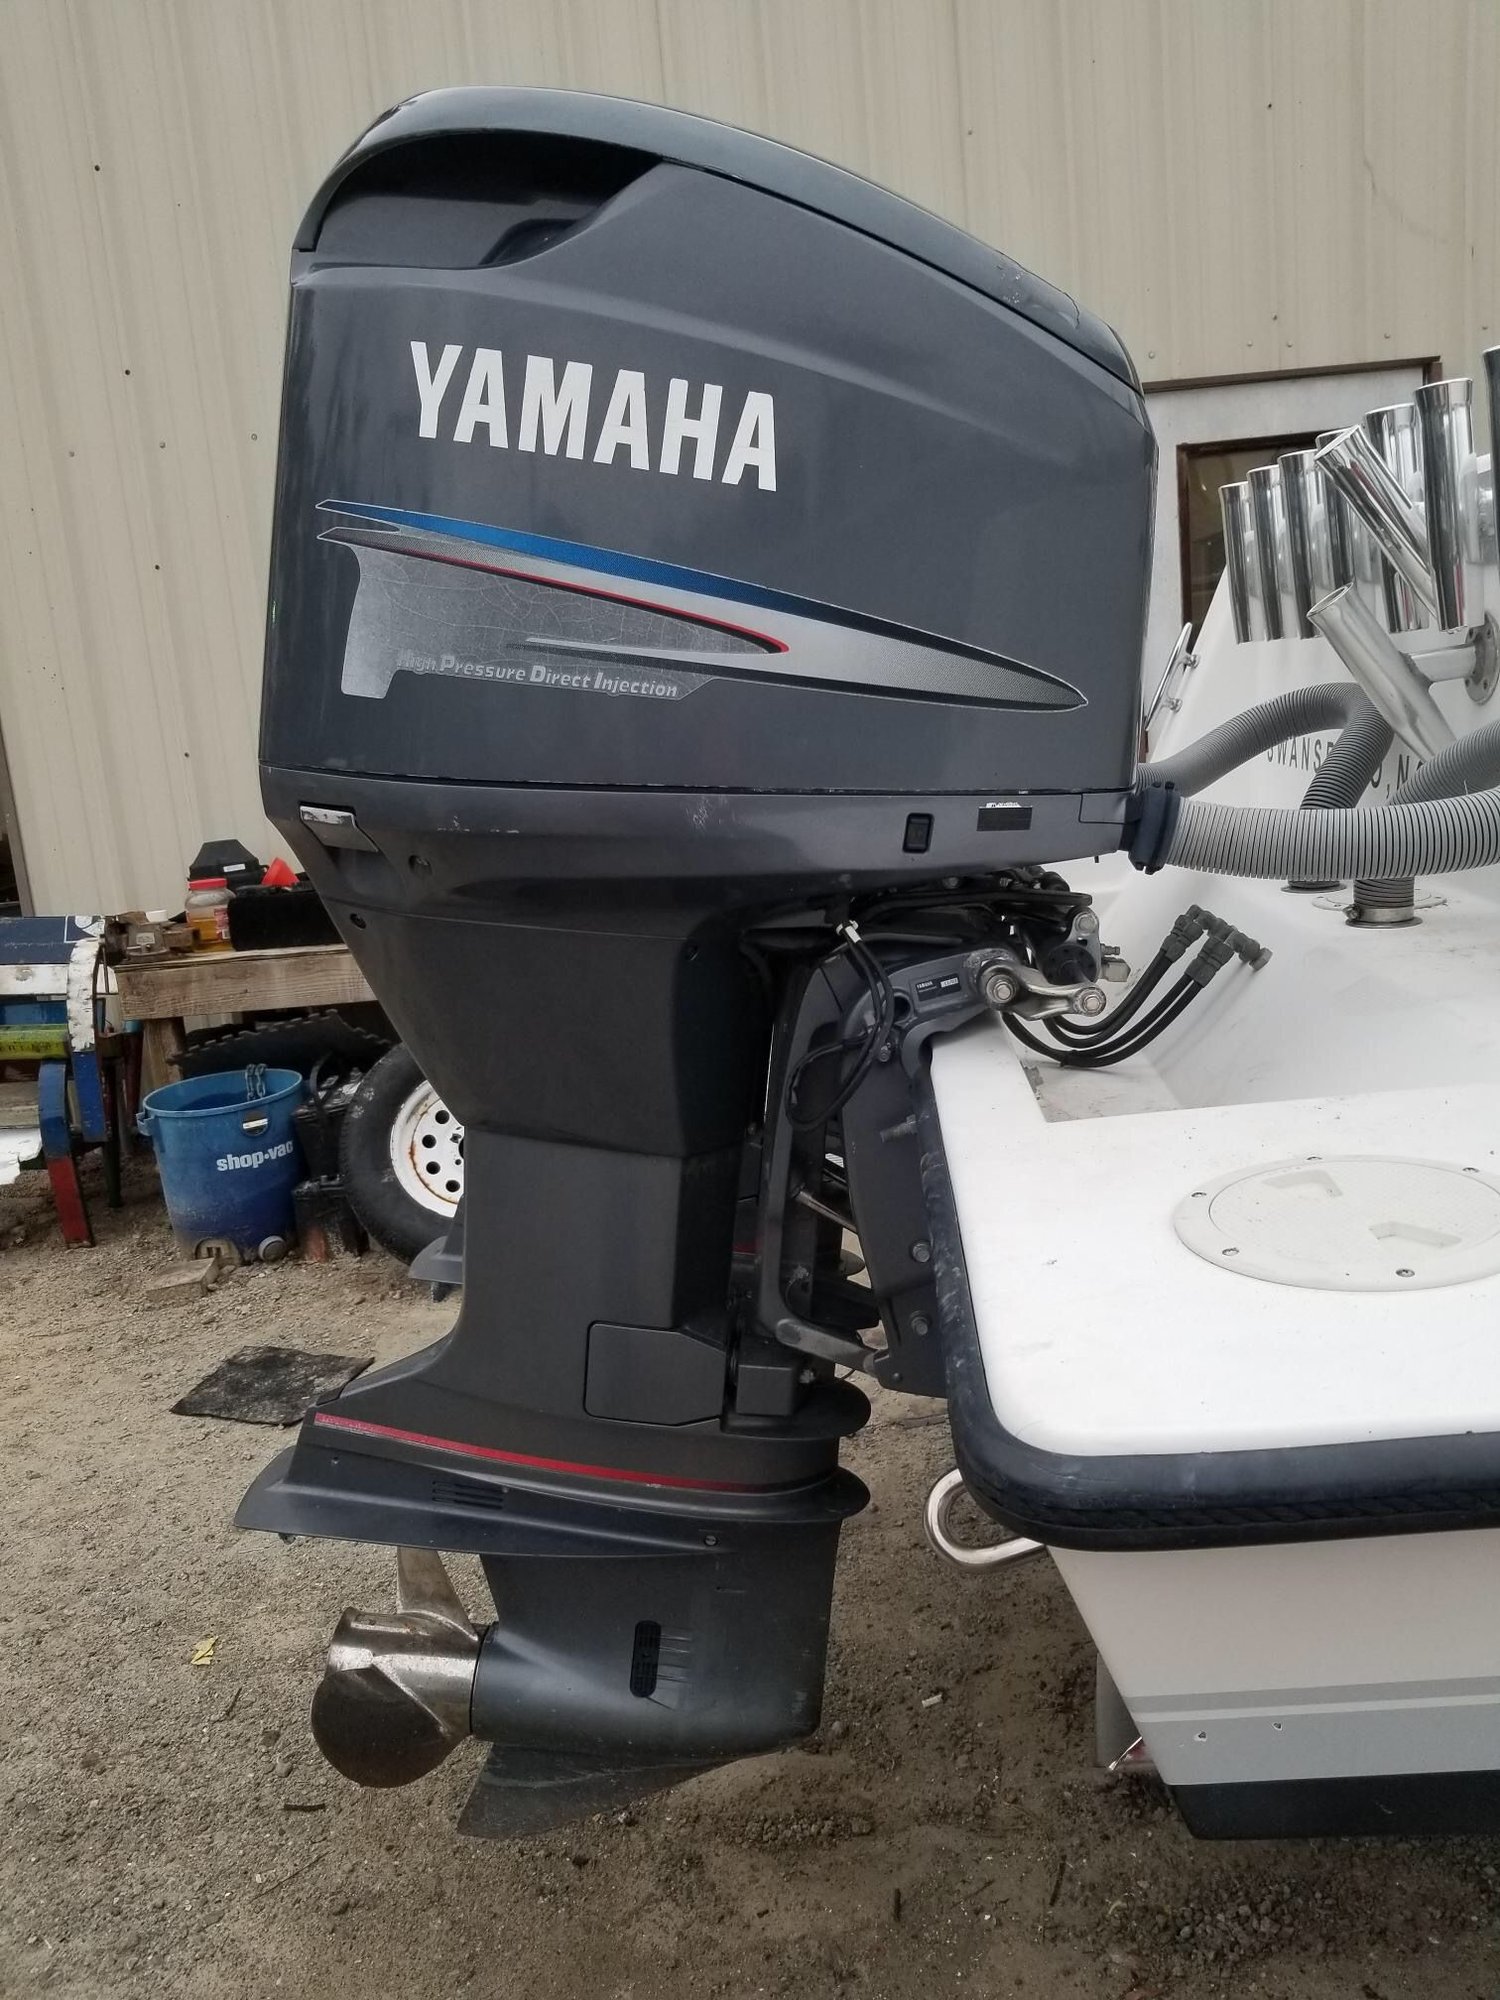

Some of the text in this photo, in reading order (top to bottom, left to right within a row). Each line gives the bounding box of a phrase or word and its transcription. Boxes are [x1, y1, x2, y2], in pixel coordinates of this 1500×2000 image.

[410, 340, 777, 492] YAMAHA
[440, 655, 526, 681] Pressure
[529, 664, 592, 688] Direct
[593, 671, 678, 698] Injection
